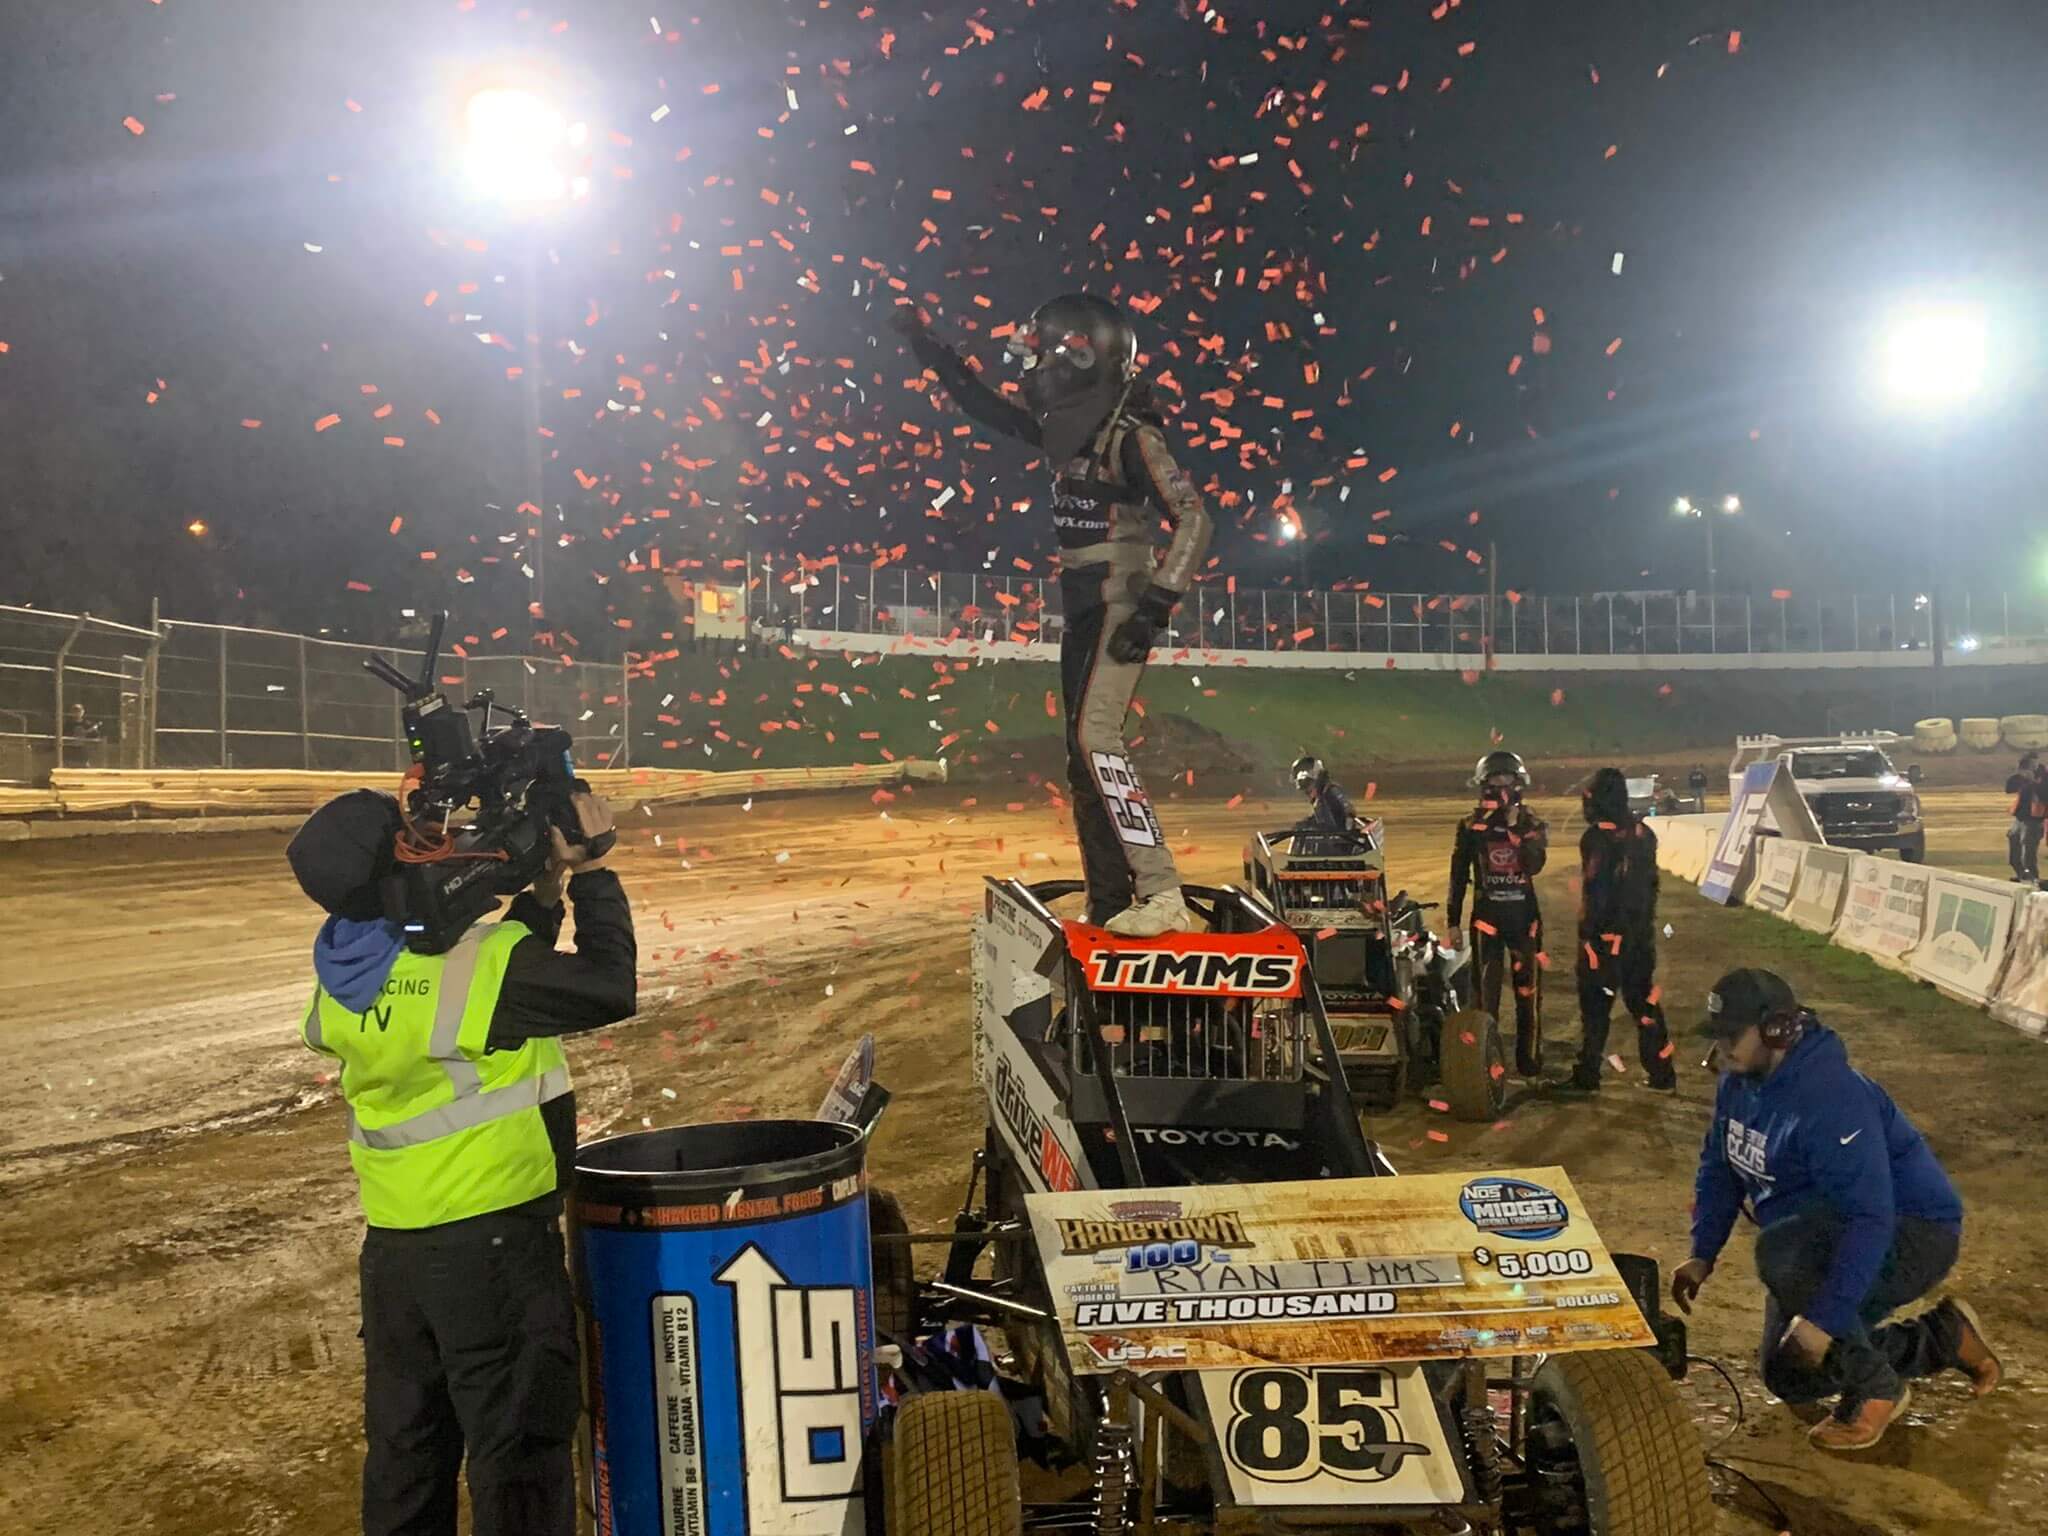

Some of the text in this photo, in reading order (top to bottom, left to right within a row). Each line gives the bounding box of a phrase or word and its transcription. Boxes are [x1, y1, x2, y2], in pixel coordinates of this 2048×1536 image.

[1135, 1128, 1289, 1148] TOYOTA
[1464, 1184, 1502, 1199] NOS
[1473, 1199, 1559, 1218] MIDGET
[1056, 1211, 1255, 1256] HANGTOWN
[1126, 1240, 1202, 1273] 100
[1474, 1247, 1592, 1279] $ 5,000
[1154, 1260, 1440, 1294] RYAN TIMMS
[1075, 1291, 1396, 1326] FIVE THOUSAND
[1556, 1293, 1620, 1308] DOLLARS
[676, 1307, 688, 1331] B12
[678, 1336, 691, 1386] VITAMIN
[1108, 1346, 1186, 1361] USAC
[663, 1308, 685, 1536] TAURINE CAFFEINE INOSITOL
[681, 1397, 696, 1455] GUARANA
[686, 1488, 699, 1536] VITAMIN
